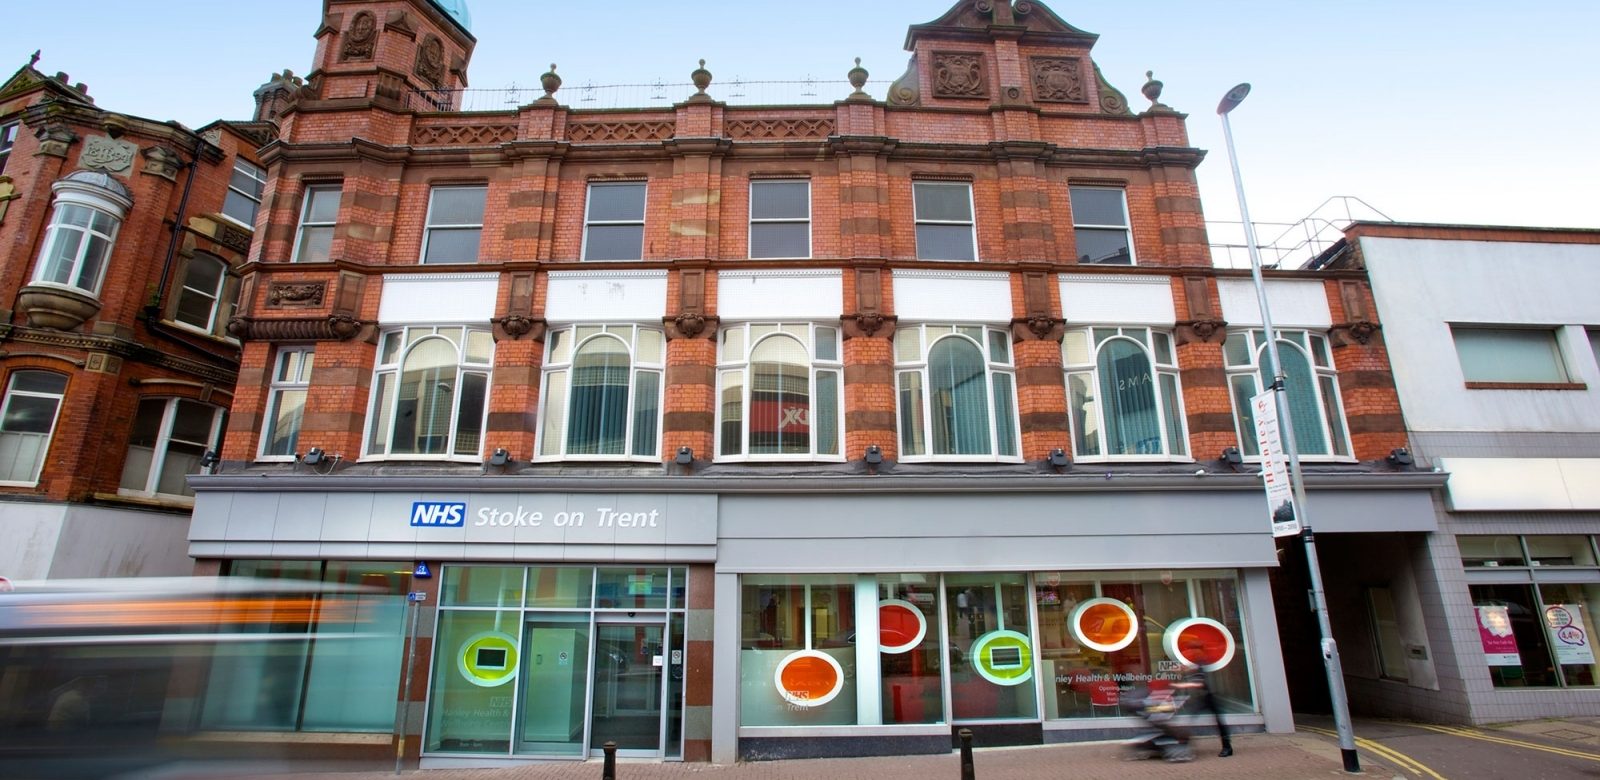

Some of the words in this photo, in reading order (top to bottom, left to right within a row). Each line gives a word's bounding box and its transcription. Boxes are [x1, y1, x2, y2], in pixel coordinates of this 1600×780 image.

[1258, 419, 1274, 484] Hanley
[411, 503, 463, 526] NHS
[474, 506, 543, 528] Stoke
[553, 510, 585, 528] on
[596, 507, 659, 528] Trent
[1159, 661, 1181, 671] NHS
[1055, 672, 1073, 684] nley
[1075, 673, 1104, 683] Health
[1104, 674, 1111, 682] &
[1113, 672, 1153, 683] Wellbeing
